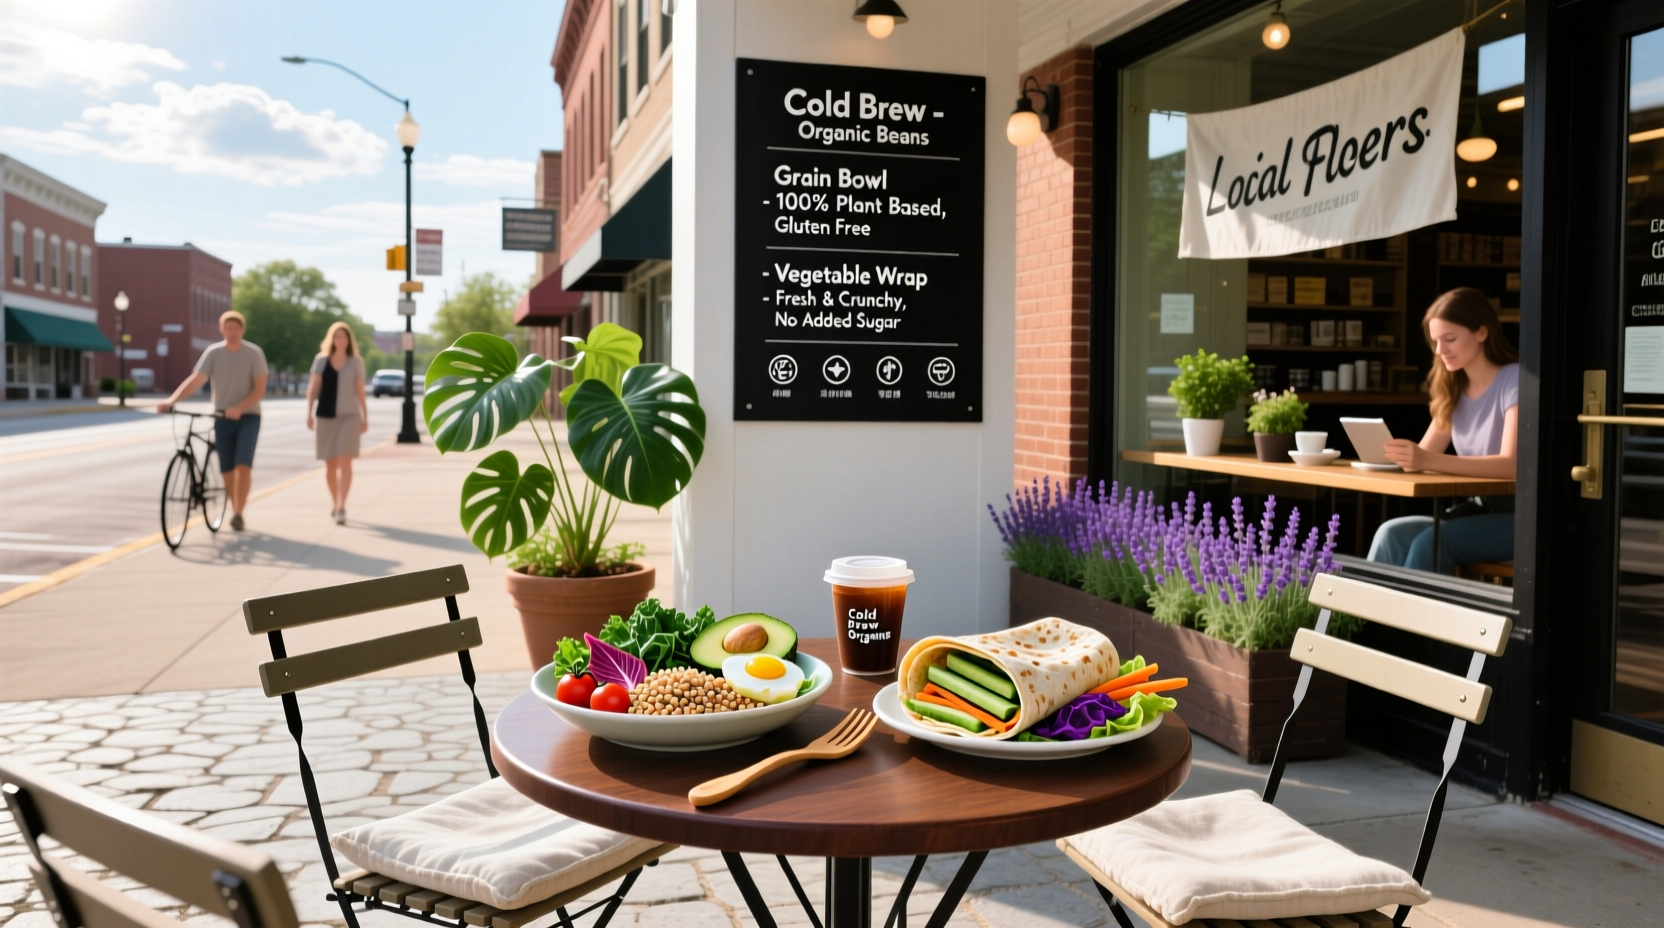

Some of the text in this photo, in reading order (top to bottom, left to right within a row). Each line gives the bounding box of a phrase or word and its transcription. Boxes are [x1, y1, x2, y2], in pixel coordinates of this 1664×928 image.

[784, 88, 851, 118] Cold
[860, 93, 927, 122] Brew
[798, 121, 930, 145] Organic Beans
[774, 165, 888, 190] Grain Bowl
[776, 192, 829, 212] 100%
[836, 194, 883, 214] Plant
[889, 197, 947, 220] Based,
[775, 216, 871, 236] Gluten Free
[775, 263, 871, 287] Vegetable
[876, 266, 928, 291] Wrap
[776, 290, 817, 307] Fresh
[823, 291, 835, 306] &
[839, 291, 907, 312] Crunchy,
[775, 311, 902, 333] No Added Sugar
[848, 607, 877, 620] Cold
